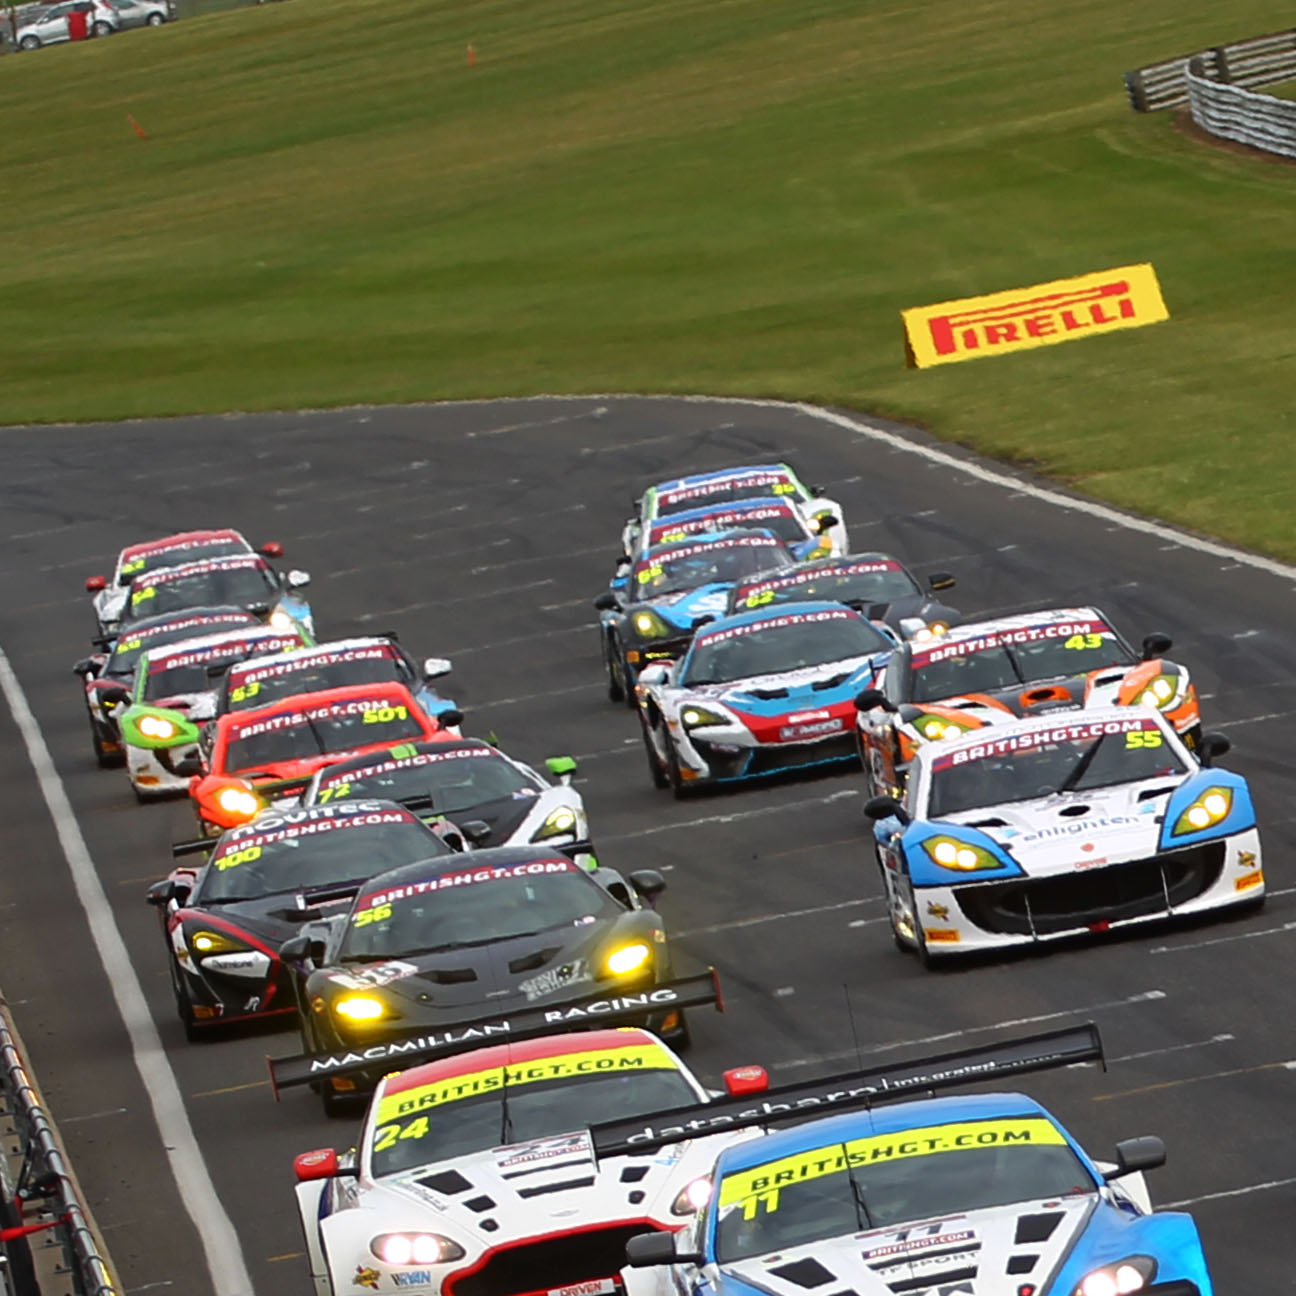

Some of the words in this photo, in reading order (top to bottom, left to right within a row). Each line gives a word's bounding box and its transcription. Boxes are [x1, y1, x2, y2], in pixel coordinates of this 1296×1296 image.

[928, 280, 1136, 356] PIRELLI
[929, 623, 1091, 664] BRITISHGT.COM
[1064, 634, 1102, 650] 43
[361, 705, 408, 725] 501
[951, 720, 1142, 765] BRITISHGT.COM
[1125, 729, 1164, 750] 55
[319, 783, 351, 804] 72
[225, 812, 403, 856] BRITISHGT.COM
[214, 846, 263, 872] 100
[370, 858, 568, 907] BRITISHGT.COM
[353, 903, 392, 928] 56
[308, 1020, 513, 1072] MACMILLAN
[543, 987, 679, 1024] RACING
[397, 1056, 645, 1115] BRITISHGT.COM
[373, 1115, 430, 1153] 24
[749, 1128, 1034, 1191] BRITISHGT.COM
[741, 1188, 781, 1221] 11
